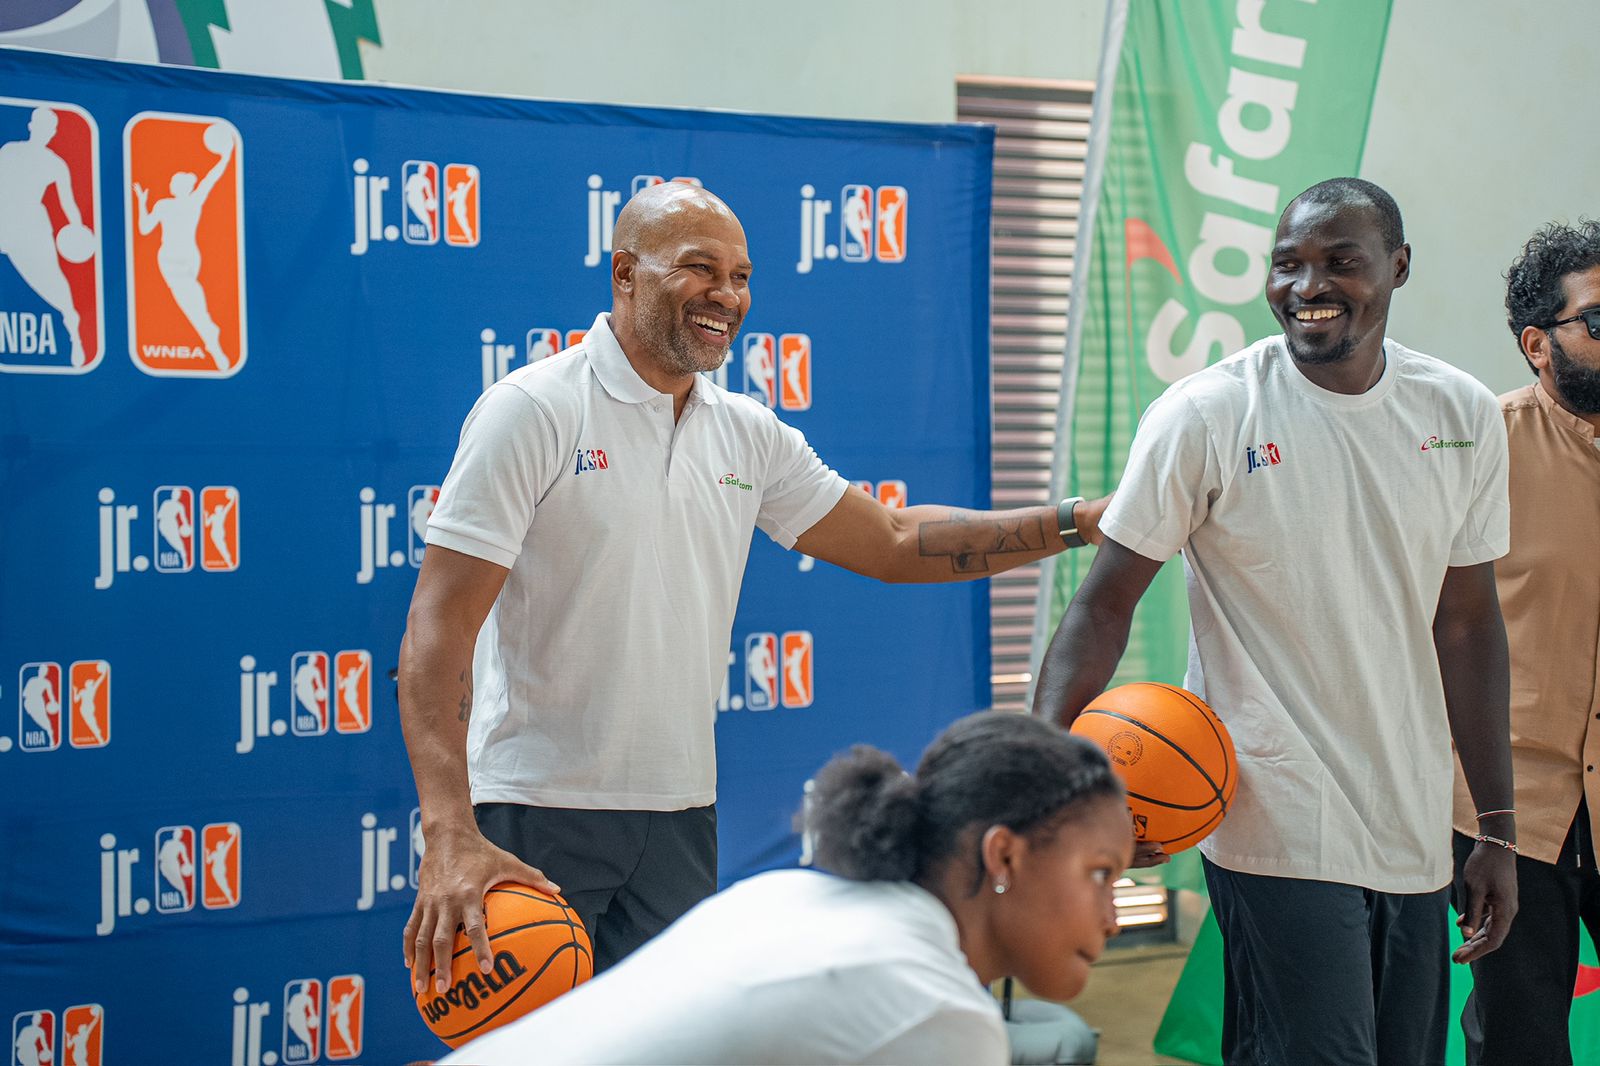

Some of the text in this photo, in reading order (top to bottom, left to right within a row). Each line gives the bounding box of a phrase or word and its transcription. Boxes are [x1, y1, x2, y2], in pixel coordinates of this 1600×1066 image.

[351, 158, 399, 255] jr.
[584, 174, 621, 267] jr
[797, 184, 838, 274] jr.
[1147, 0, 1308, 384] Safar
[0, 311, 57, 355] NBA
[142, 344, 206, 359] WNBA
[480, 328, 515, 391] jr
[95, 487, 149, 589] jr.
[357, 487, 405, 584] jr.
[25, 730, 46, 747] NBA
[236, 655, 287, 753] jr.
[96, 833, 150, 936] jr.
[357, 812, 406, 911] jr.
[232, 987, 278, 1066] jr.
[422, 950, 527, 1025] Wilson
